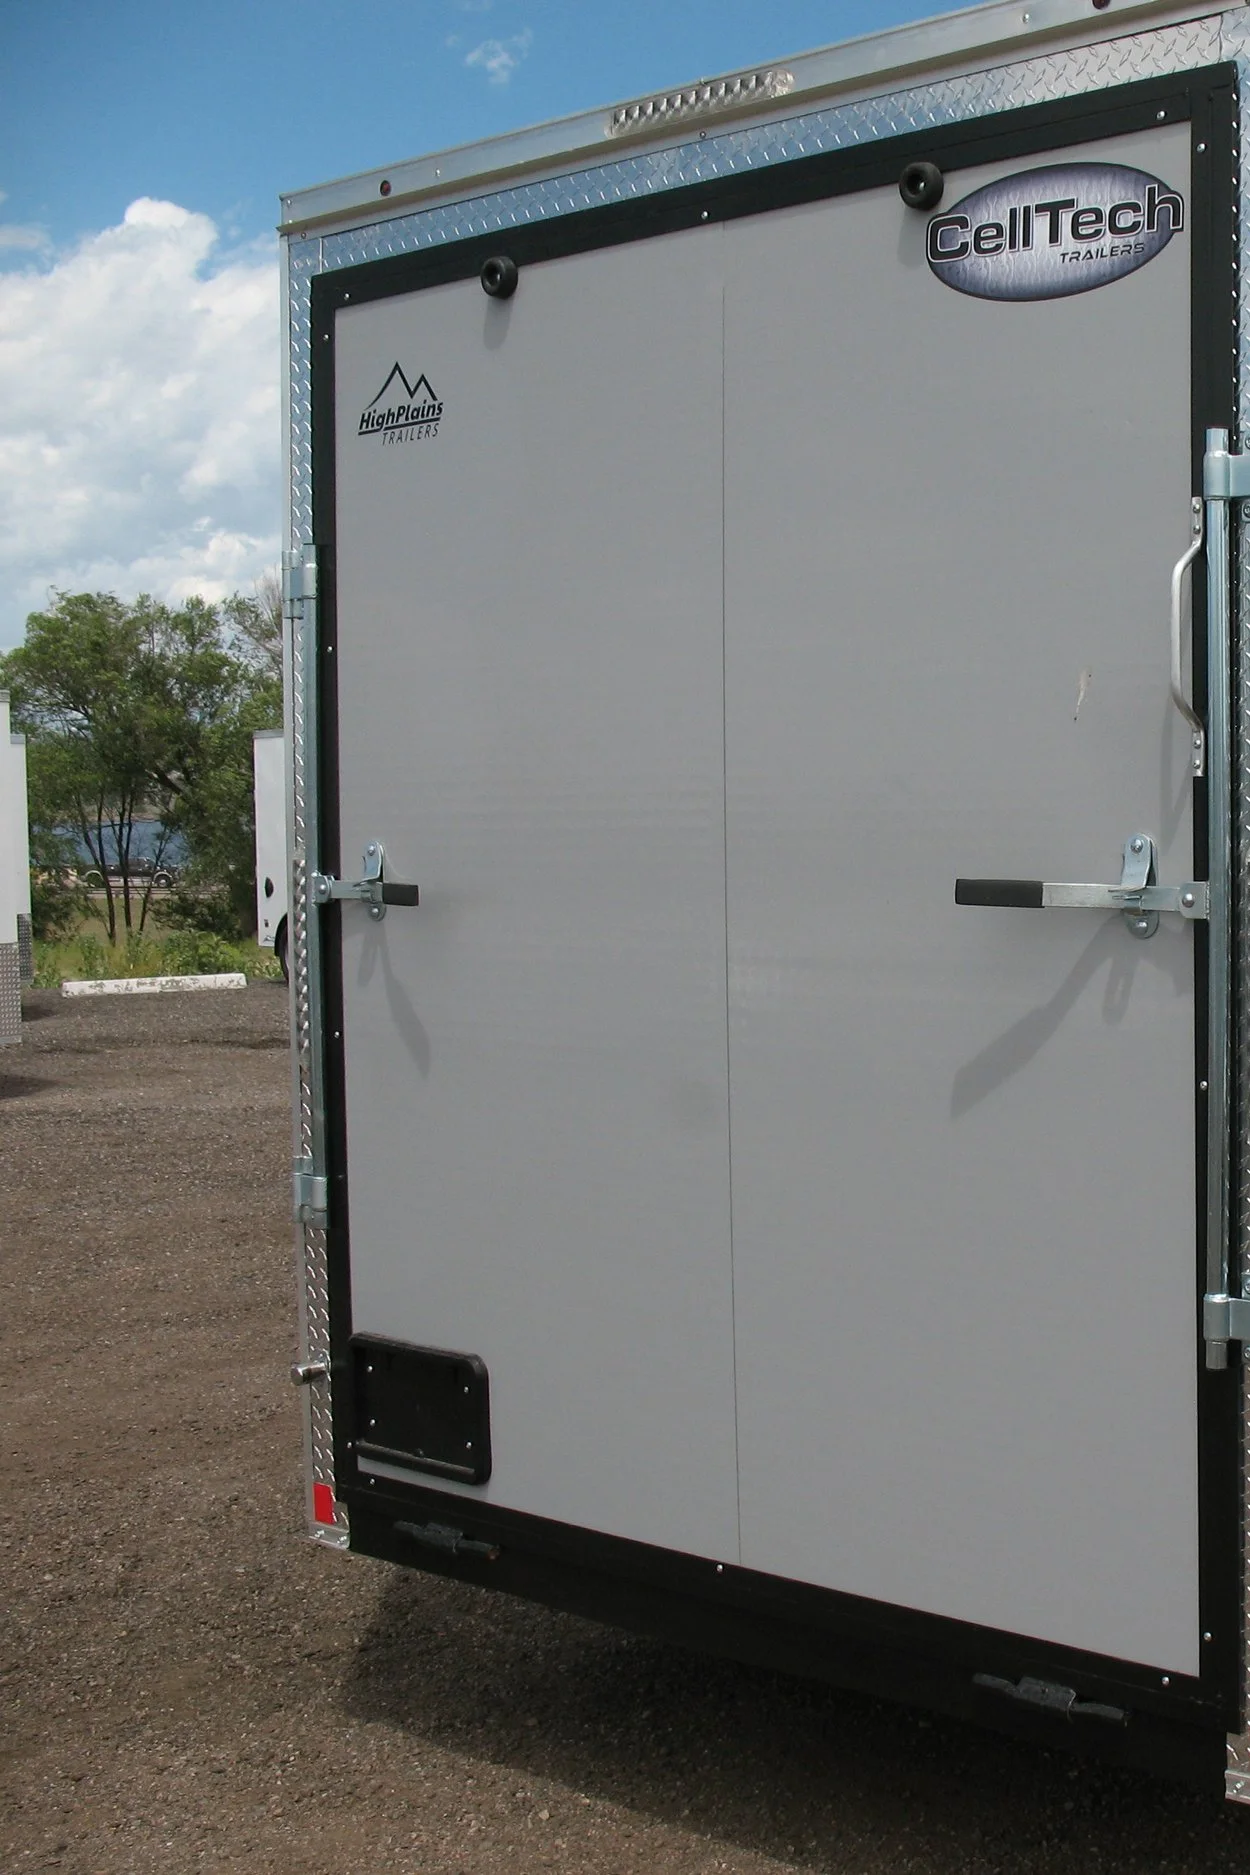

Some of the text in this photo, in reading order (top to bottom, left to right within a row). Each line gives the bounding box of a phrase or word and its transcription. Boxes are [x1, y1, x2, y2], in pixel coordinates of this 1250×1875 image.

[926, 184, 1185, 263] CellTech
[1060, 242, 1145, 264] TRAILERS
[359, 399, 443, 431] HighPlains
[382, 422, 439, 446] TRAILERS
